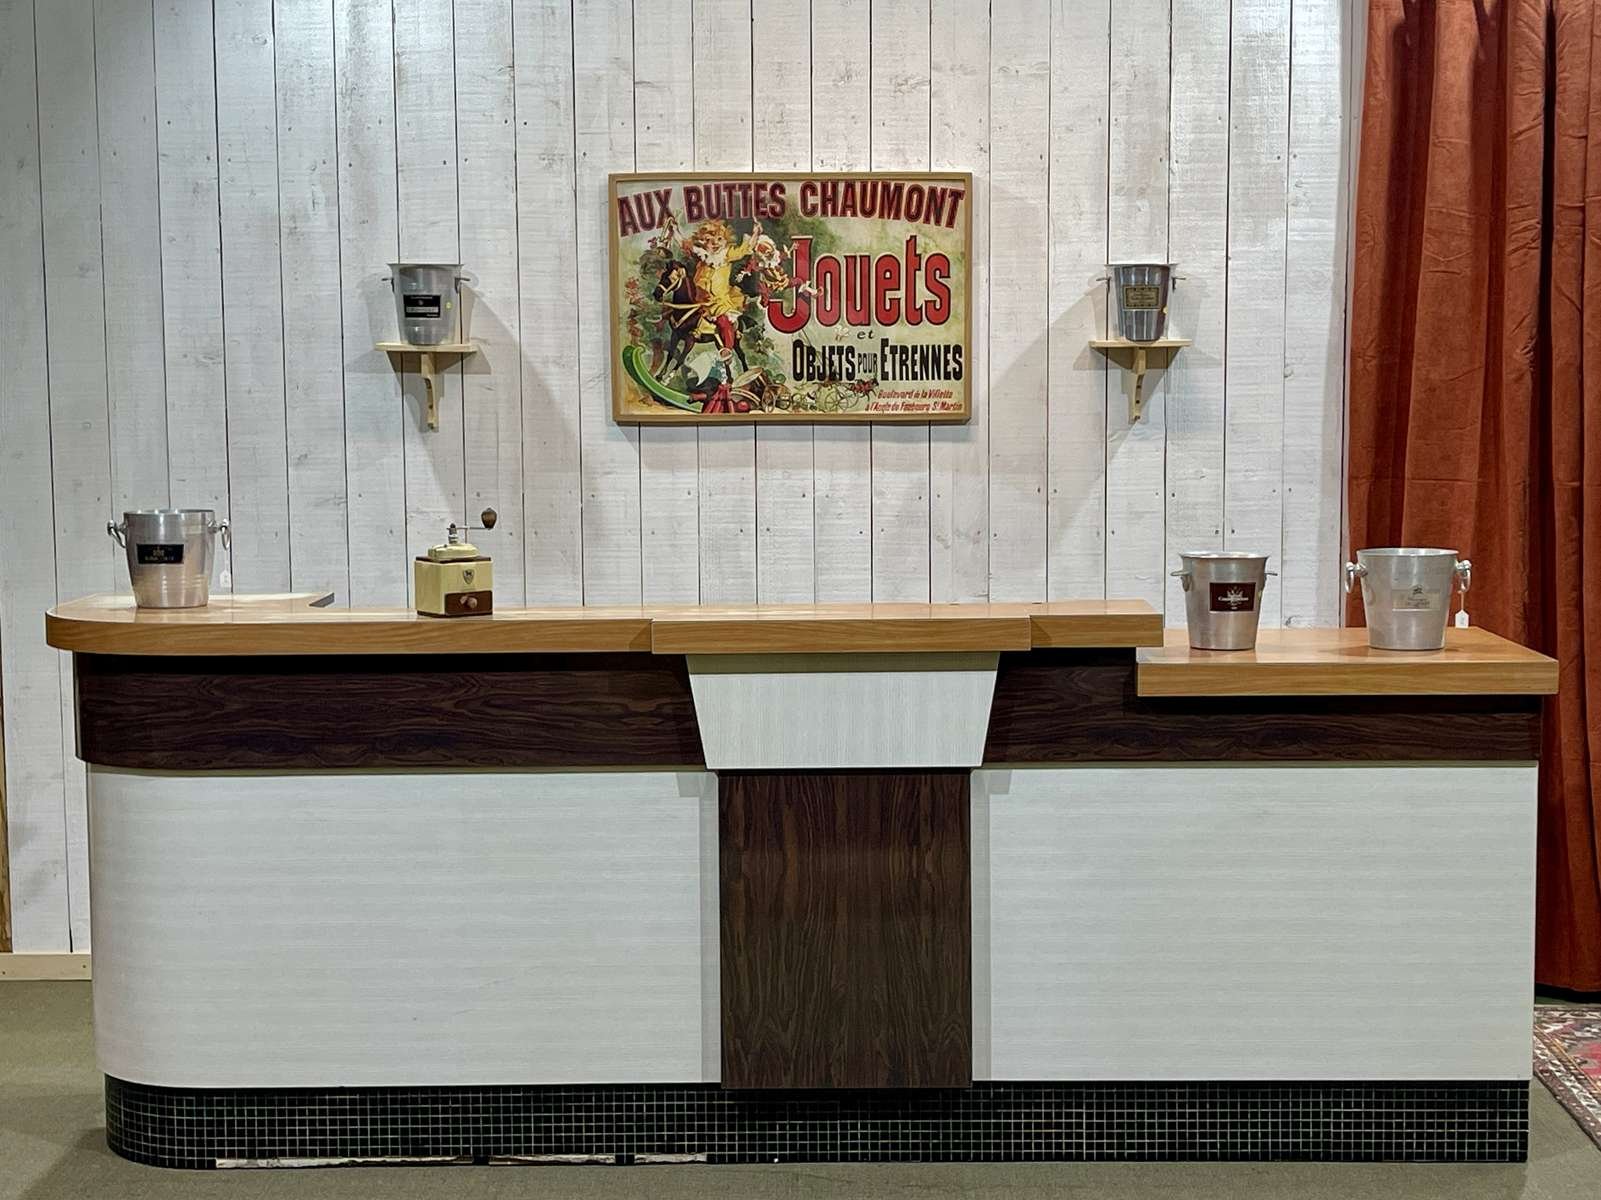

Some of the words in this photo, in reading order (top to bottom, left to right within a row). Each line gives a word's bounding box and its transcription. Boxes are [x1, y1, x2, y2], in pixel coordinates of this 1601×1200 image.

[617, 188, 674, 237] AUX
[683, 182, 786, 224] BUTTES
[800, 180, 966, 229] CHAUMONT
[766, 235, 951, 334] Jouets
[857, 330, 874, 340] et
[792, 339, 856, 382] OBJETS
[857, 352, 878, 374] POUR
[880, 338, 963, 381] ETRENNES
[921, 390, 928, 399] la
